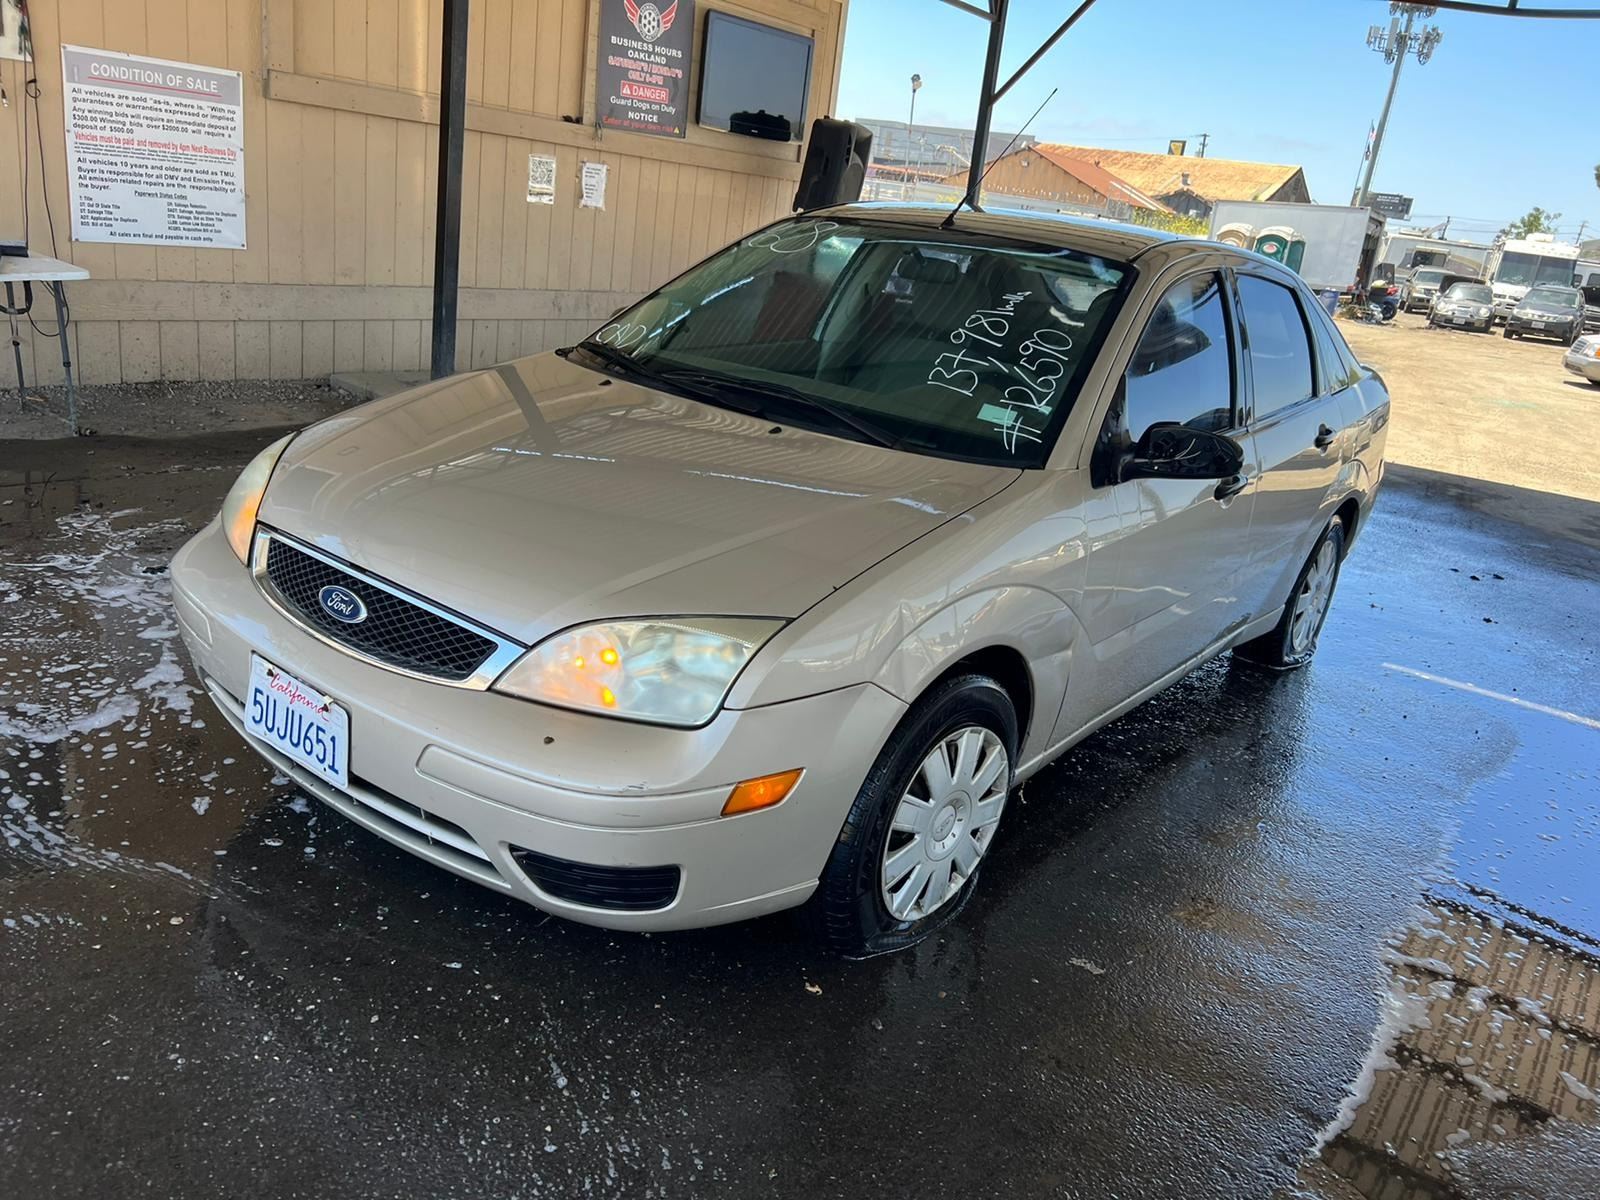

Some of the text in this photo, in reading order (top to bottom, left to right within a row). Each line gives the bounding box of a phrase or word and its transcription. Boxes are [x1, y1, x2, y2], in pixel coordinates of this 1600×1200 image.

[611, 36, 682, 58] BUSINESS HOURS
[628, 50, 666, 64] OAKLAND
[90, 61, 218, 92] CONDITION OF SALE
[84, 89, 114, 98] vehicles
[633, 87, 666, 100] DANGER
[72, 96, 113, 107] guarantees
[125, 102, 162, 112] warranties
[164, 108, 199, 117] expressed
[72, 105, 85, 113] Any
[87, 107, 113, 117] winning
[142, 114, 164, 123] require
[175, 118, 205, 127] immediate
[610, 96, 631, 106] Guard
[633, 100, 650, 110] Dogs
[661, 104, 676, 115] Duty
[72, 113, 97, 122] $300.00
[98, 116, 126, 126] Winning
[162, 124, 188, 132] $2000.00
[204, 129, 224, 138] require
[72, 121, 97, 130] deposit
[628, 111, 658, 122] NOTICE
[74, 131, 97, 141] Vehicles
[98, 133, 112, 143] must
[114, 135, 120, 144] be
[122, 136, 134, 146] paid
[136, 138, 146, 146] and
[147, 139, 169, 149] removed
[171, 141, 177, 151] by
[191, 144, 202, 152] Next
[204, 145, 225, 155] Business
[227, 148, 235, 157] Day
[77, 165, 97, 174] Buyer
[106, 168, 143, 178] responsible
[189, 184, 228, 193] responsibility
[994, 328, 1073, 454] #126590
[327, 590, 354, 615] Ford
[269, 672, 331, 722] California
[252, 688, 339, 775] 5UJU651
